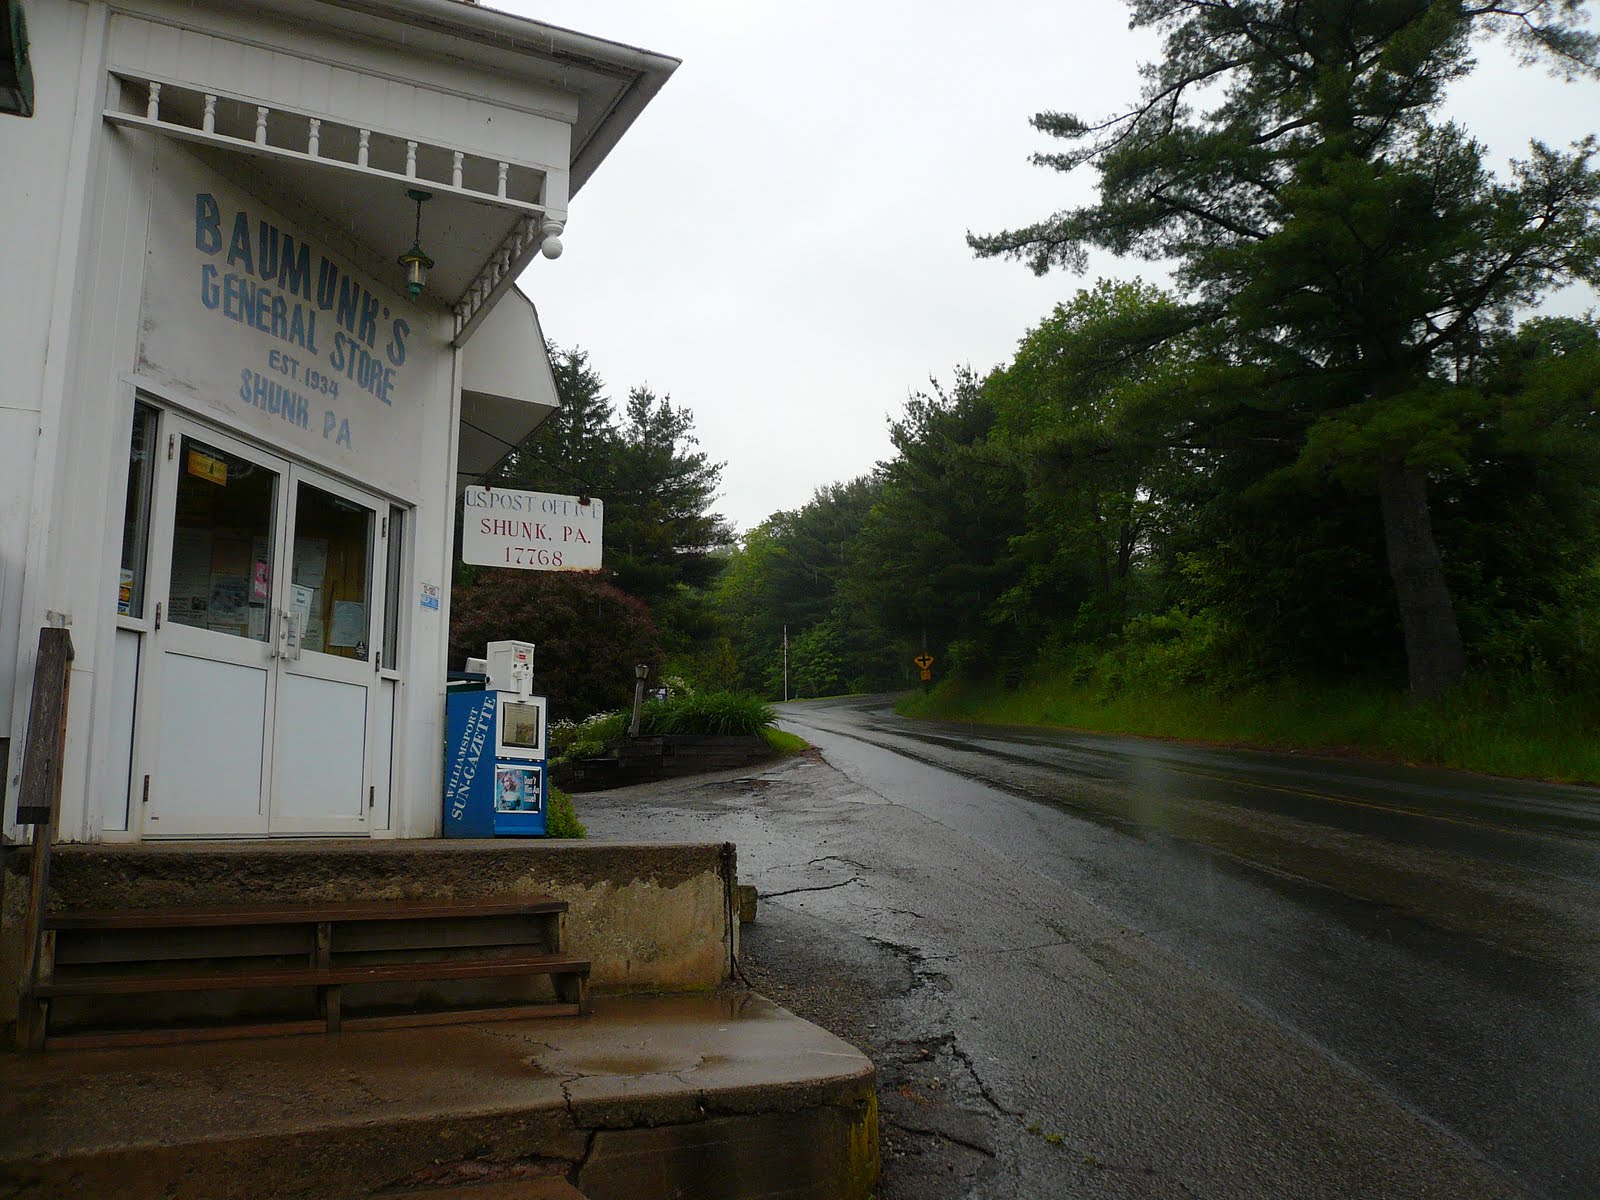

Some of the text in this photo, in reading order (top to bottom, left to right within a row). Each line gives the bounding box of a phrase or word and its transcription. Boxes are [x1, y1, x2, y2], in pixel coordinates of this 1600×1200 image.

[195, 192, 410, 367] BAUMUNK'S
[201, 263, 396, 407] GENERAL STORE
[239, 367, 309, 431] SHUNK
[304, 367, 339, 401] 1934
[489, 492, 536, 513] POST
[504, 546, 564, 567] 17768
[562, 525, 592, 545] PA.
[446, 706, 479, 799] WILLIAMSPORT
[451, 696, 497, 822] SUN-GAZETTE
